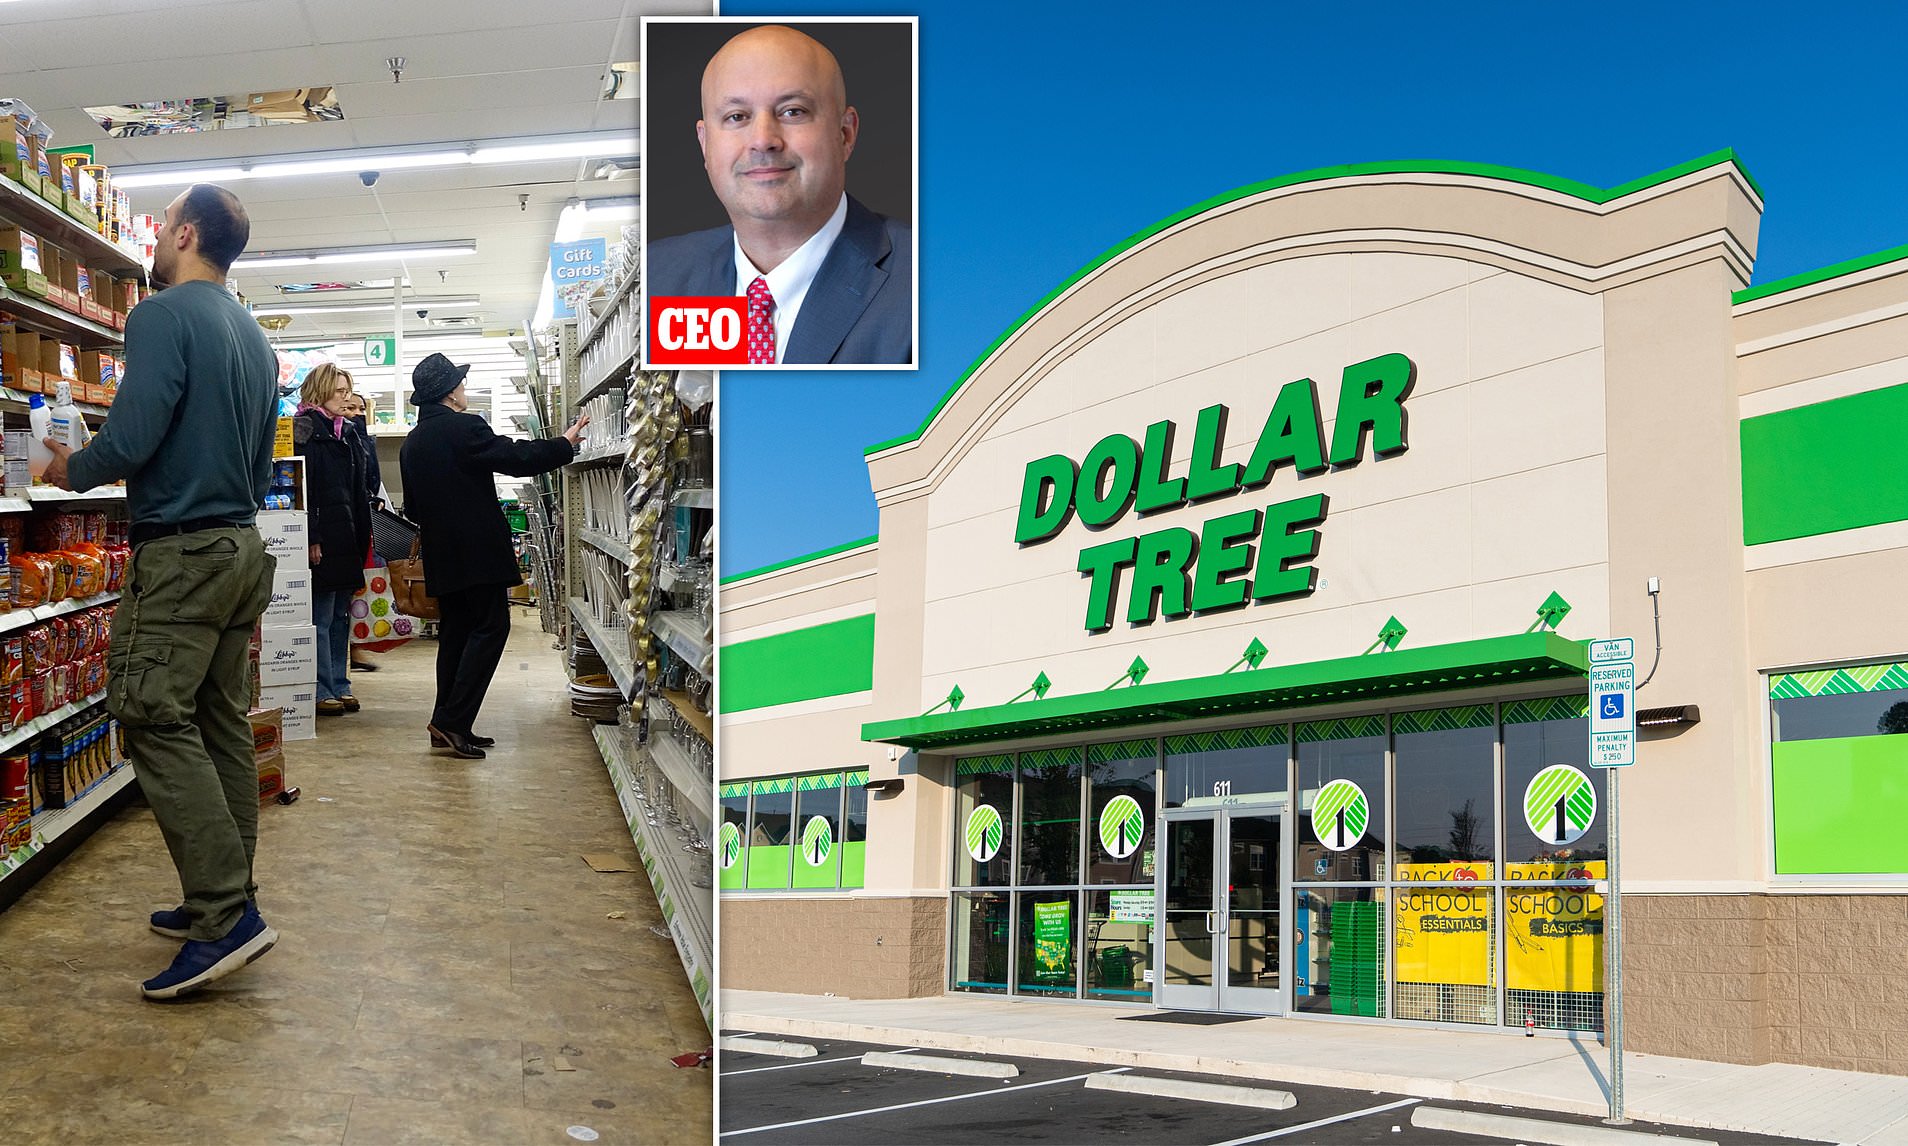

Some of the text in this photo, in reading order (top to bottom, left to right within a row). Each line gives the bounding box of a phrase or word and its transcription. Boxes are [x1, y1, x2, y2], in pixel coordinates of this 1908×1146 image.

[564, 248, 592, 262] Gift
[557, 264, 601, 278] Cards
[370, 345, 382, 359] 4
[1014, 353, 1417, 546] DOLLAR
[1077, 493, 1330, 633] TREE
[1604, 643, 1620, 652] VAN
[1592, 669, 1632, 680] RESERVED
[1594, 681, 1630, 692] PARKING
[1596, 734, 1628, 742] MAXIMUM
[1597, 743, 1627, 751] PENALTY
[1214, 780, 1231, 797] 611
[1401, 870, 1454, 890] BACK
[1511, 870, 1566, 890] BACK
[1400, 894, 1482, 911] SCHOOL
[1510, 894, 1598, 915] SCHOOL
[1422, 919, 1482, 929] ESSENTIALS
[1542, 923, 1584, 934] BASICS
